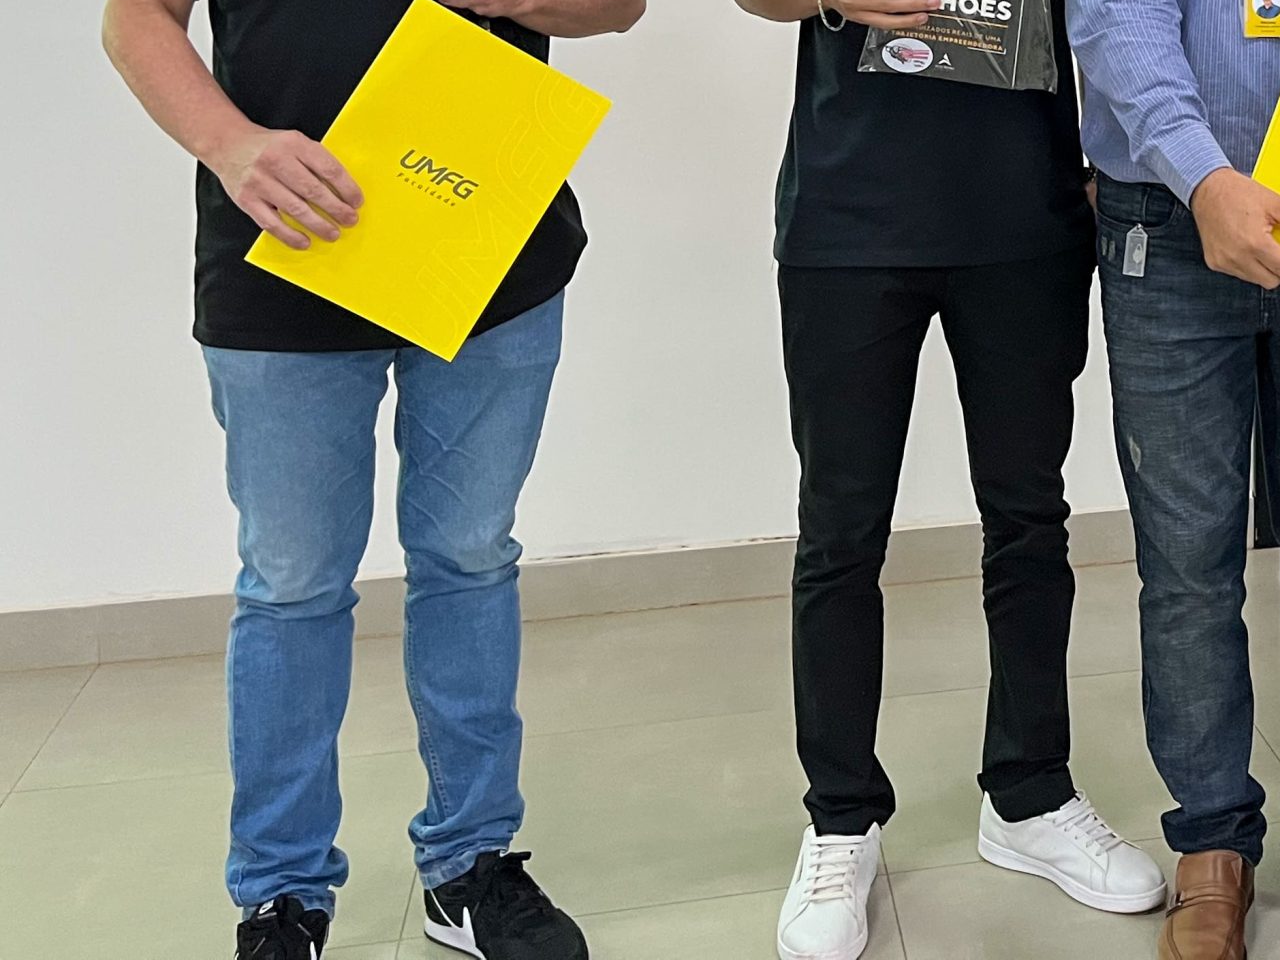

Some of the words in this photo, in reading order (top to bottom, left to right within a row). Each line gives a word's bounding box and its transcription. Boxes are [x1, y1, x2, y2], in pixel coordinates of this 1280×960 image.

[984, 34, 1002, 43] UMA
[396, 172, 456, 207] Faculdade
[400, 149, 479, 200] UMFG
